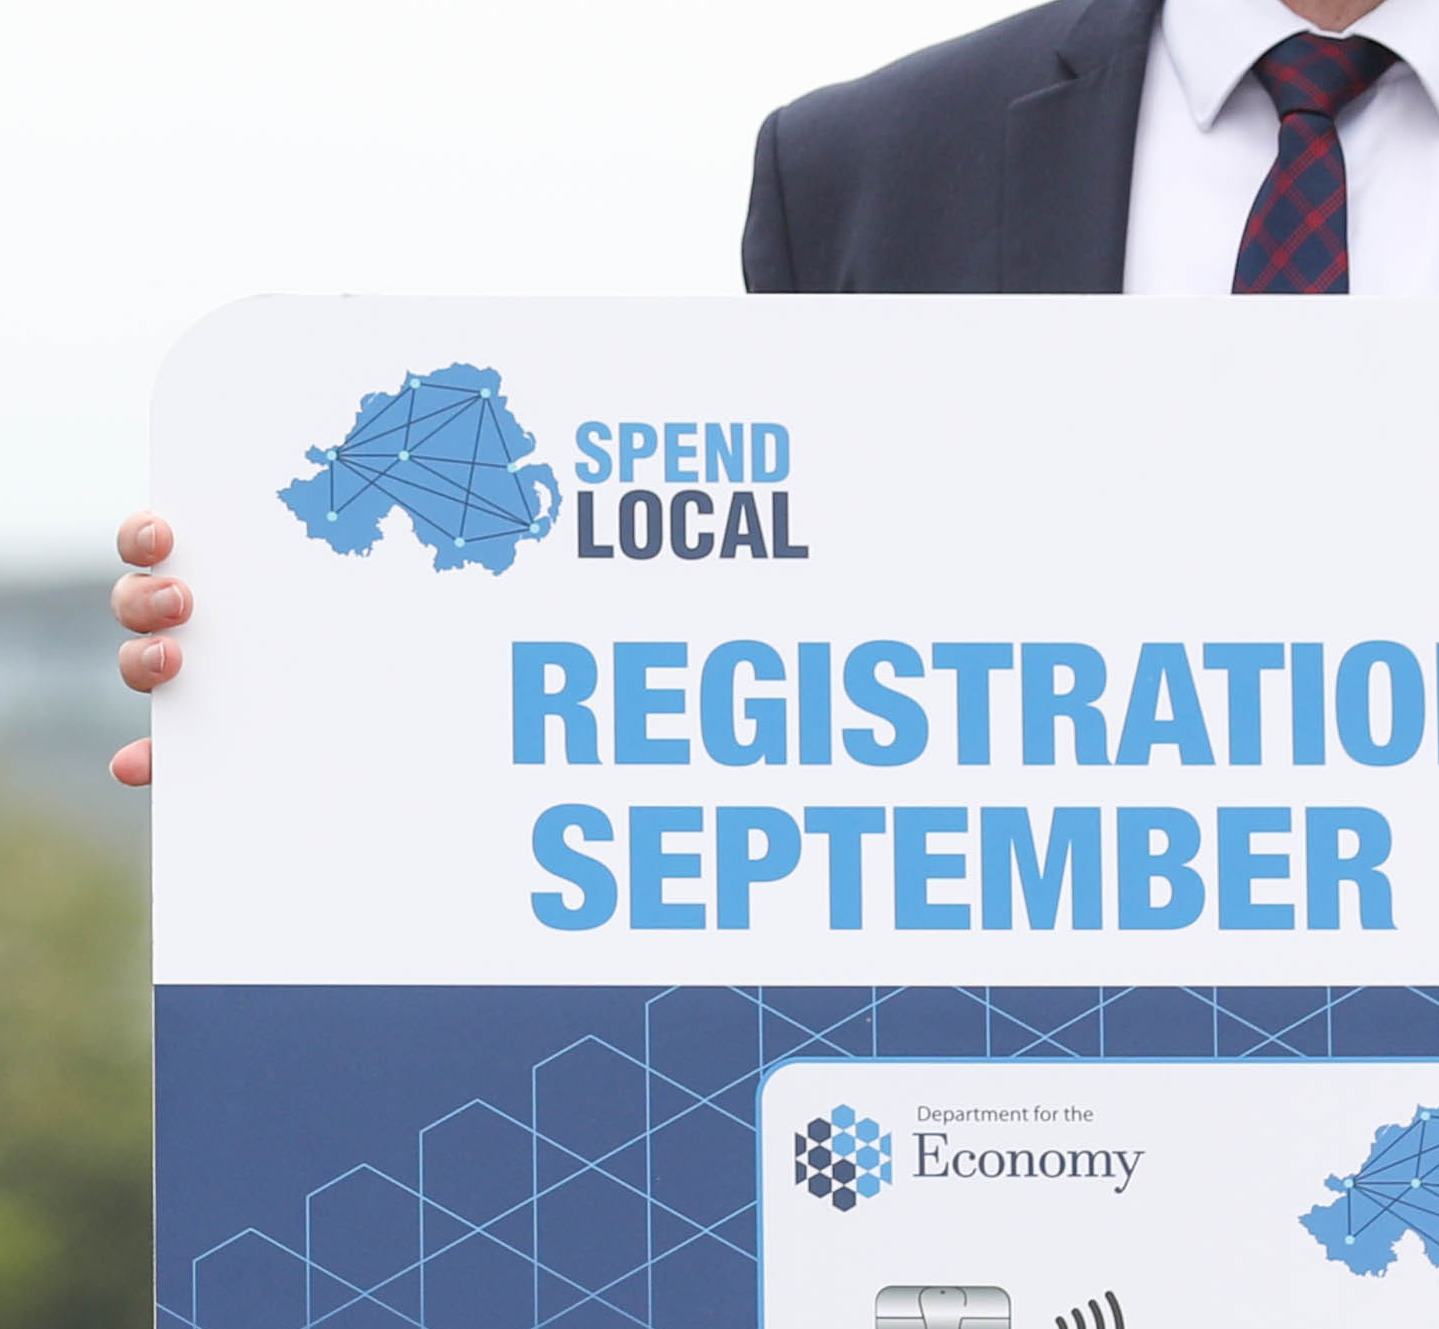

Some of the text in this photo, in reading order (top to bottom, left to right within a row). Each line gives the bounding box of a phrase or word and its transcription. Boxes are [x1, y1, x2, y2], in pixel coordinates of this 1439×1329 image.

[574, 420, 791, 485] SPEND
[576, 489, 810, 561] LOCAL
[530, 803, 1398, 932] SEPTEMBER
[917, 1104, 1094, 1126] Department for the
[912, 1132, 1146, 1194] Economy
